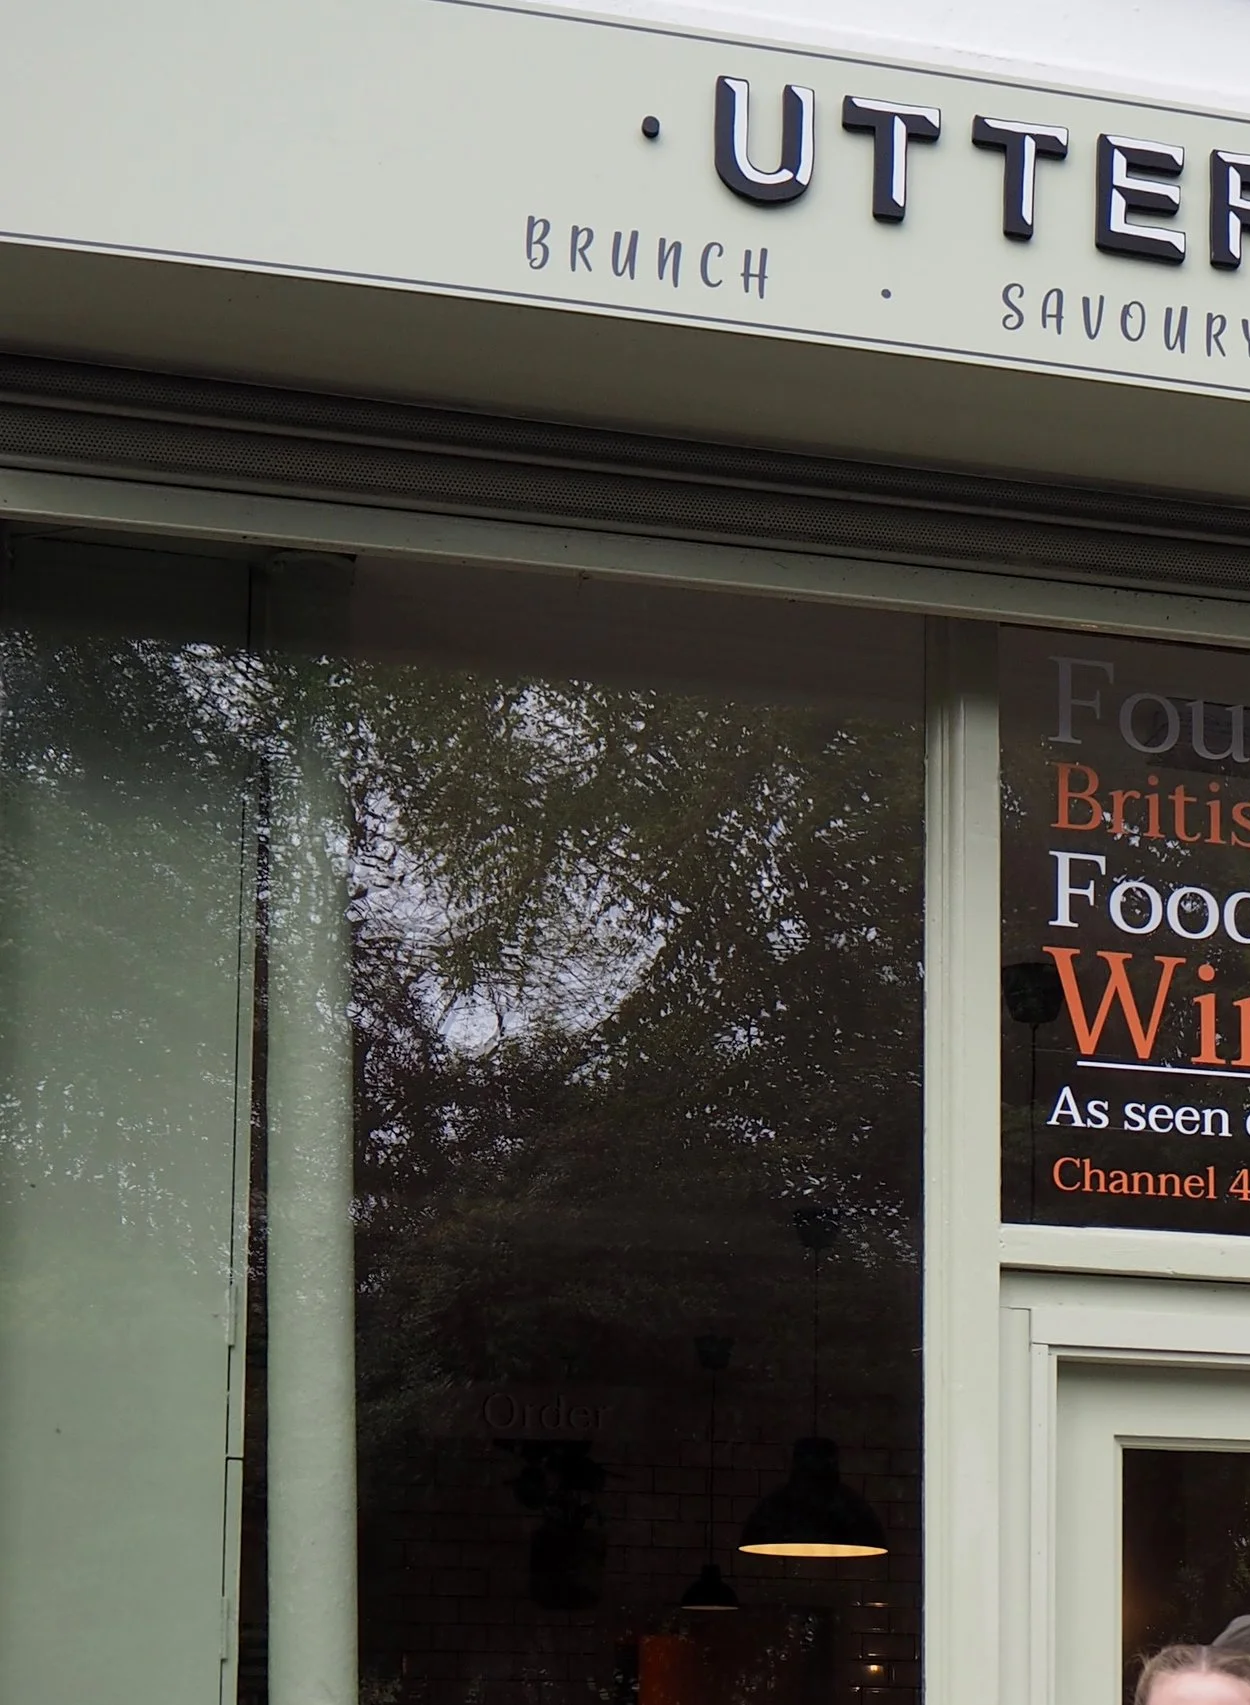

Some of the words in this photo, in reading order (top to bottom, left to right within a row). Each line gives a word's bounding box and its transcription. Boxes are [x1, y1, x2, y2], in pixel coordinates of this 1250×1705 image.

[524, 213, 771, 302] BRUNCH
[1046, 1085, 1110, 1129] As
[1123, 1098, 1233, 1138] seen
[1052, 1156, 1217, 1201] Channel
